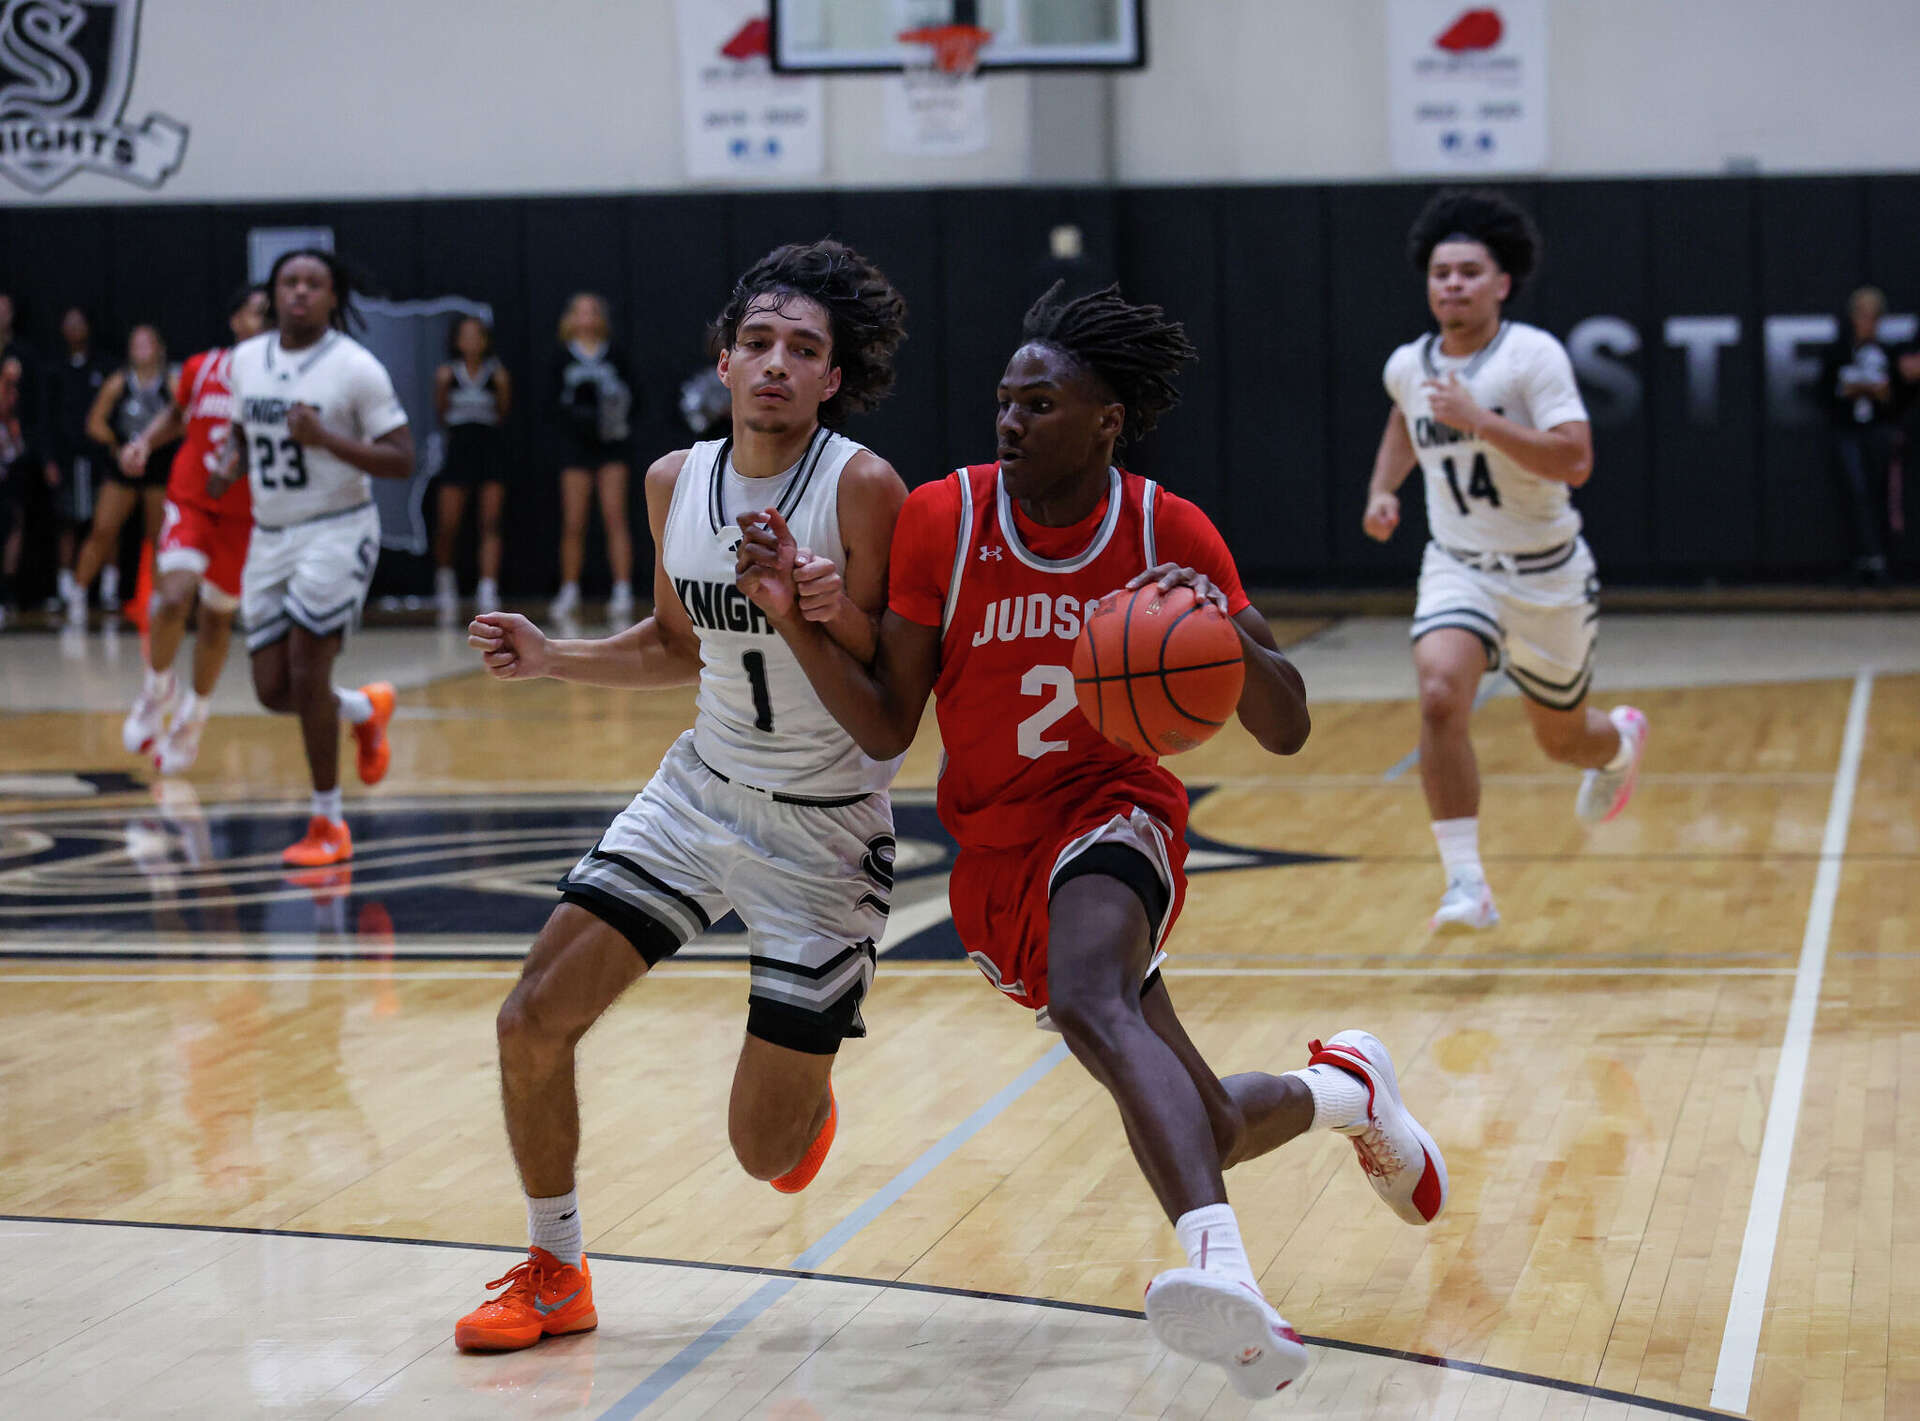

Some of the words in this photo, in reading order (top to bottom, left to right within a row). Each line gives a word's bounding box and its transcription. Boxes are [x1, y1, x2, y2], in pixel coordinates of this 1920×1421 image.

[0, 127, 134, 166] IGHTS
[1567, 316, 1918, 426] STE
[256, 433, 310, 489] 23
[1441, 452, 1502, 517] 14
[742, 649, 775, 734] 1
[1017, 664, 1080, 760] 2
